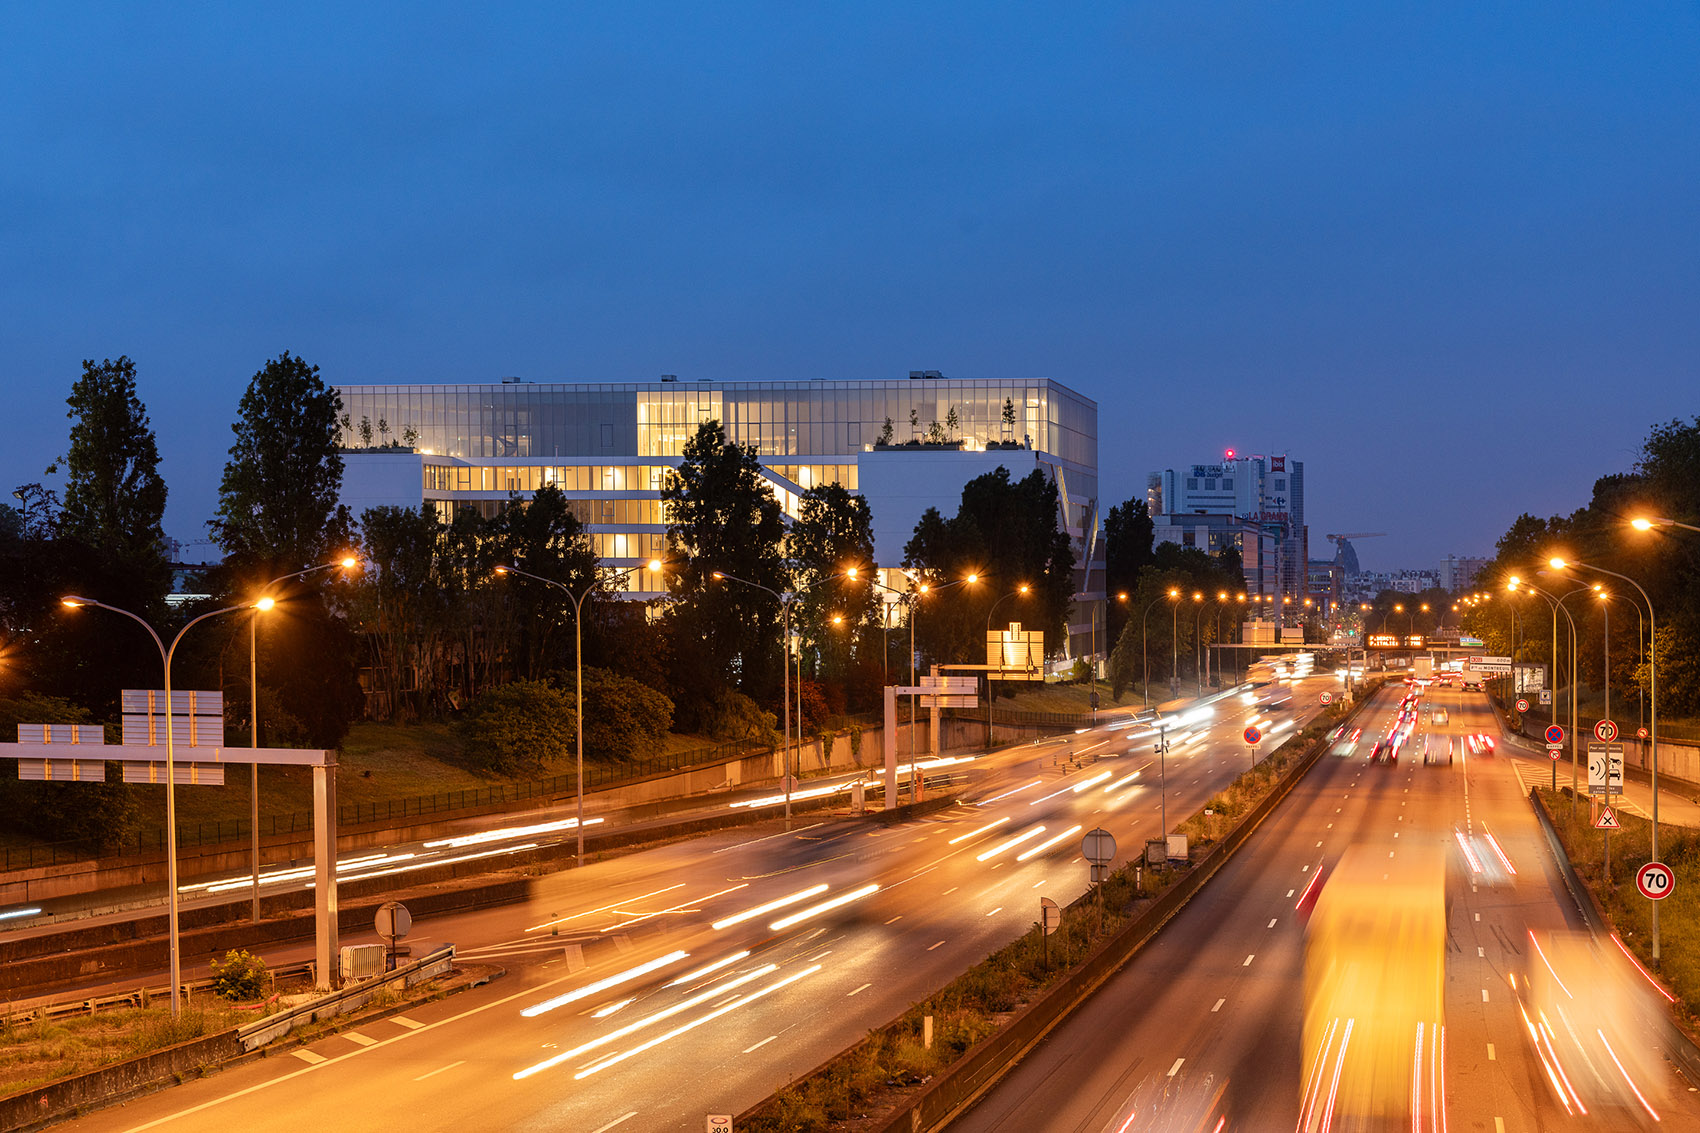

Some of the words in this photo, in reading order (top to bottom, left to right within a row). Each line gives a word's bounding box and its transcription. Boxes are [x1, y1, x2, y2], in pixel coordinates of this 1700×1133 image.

[1248, 512, 1259, 520] LA
[1600, 726, 1613, 736] 70
[1645, 873, 1667, 889] 70
